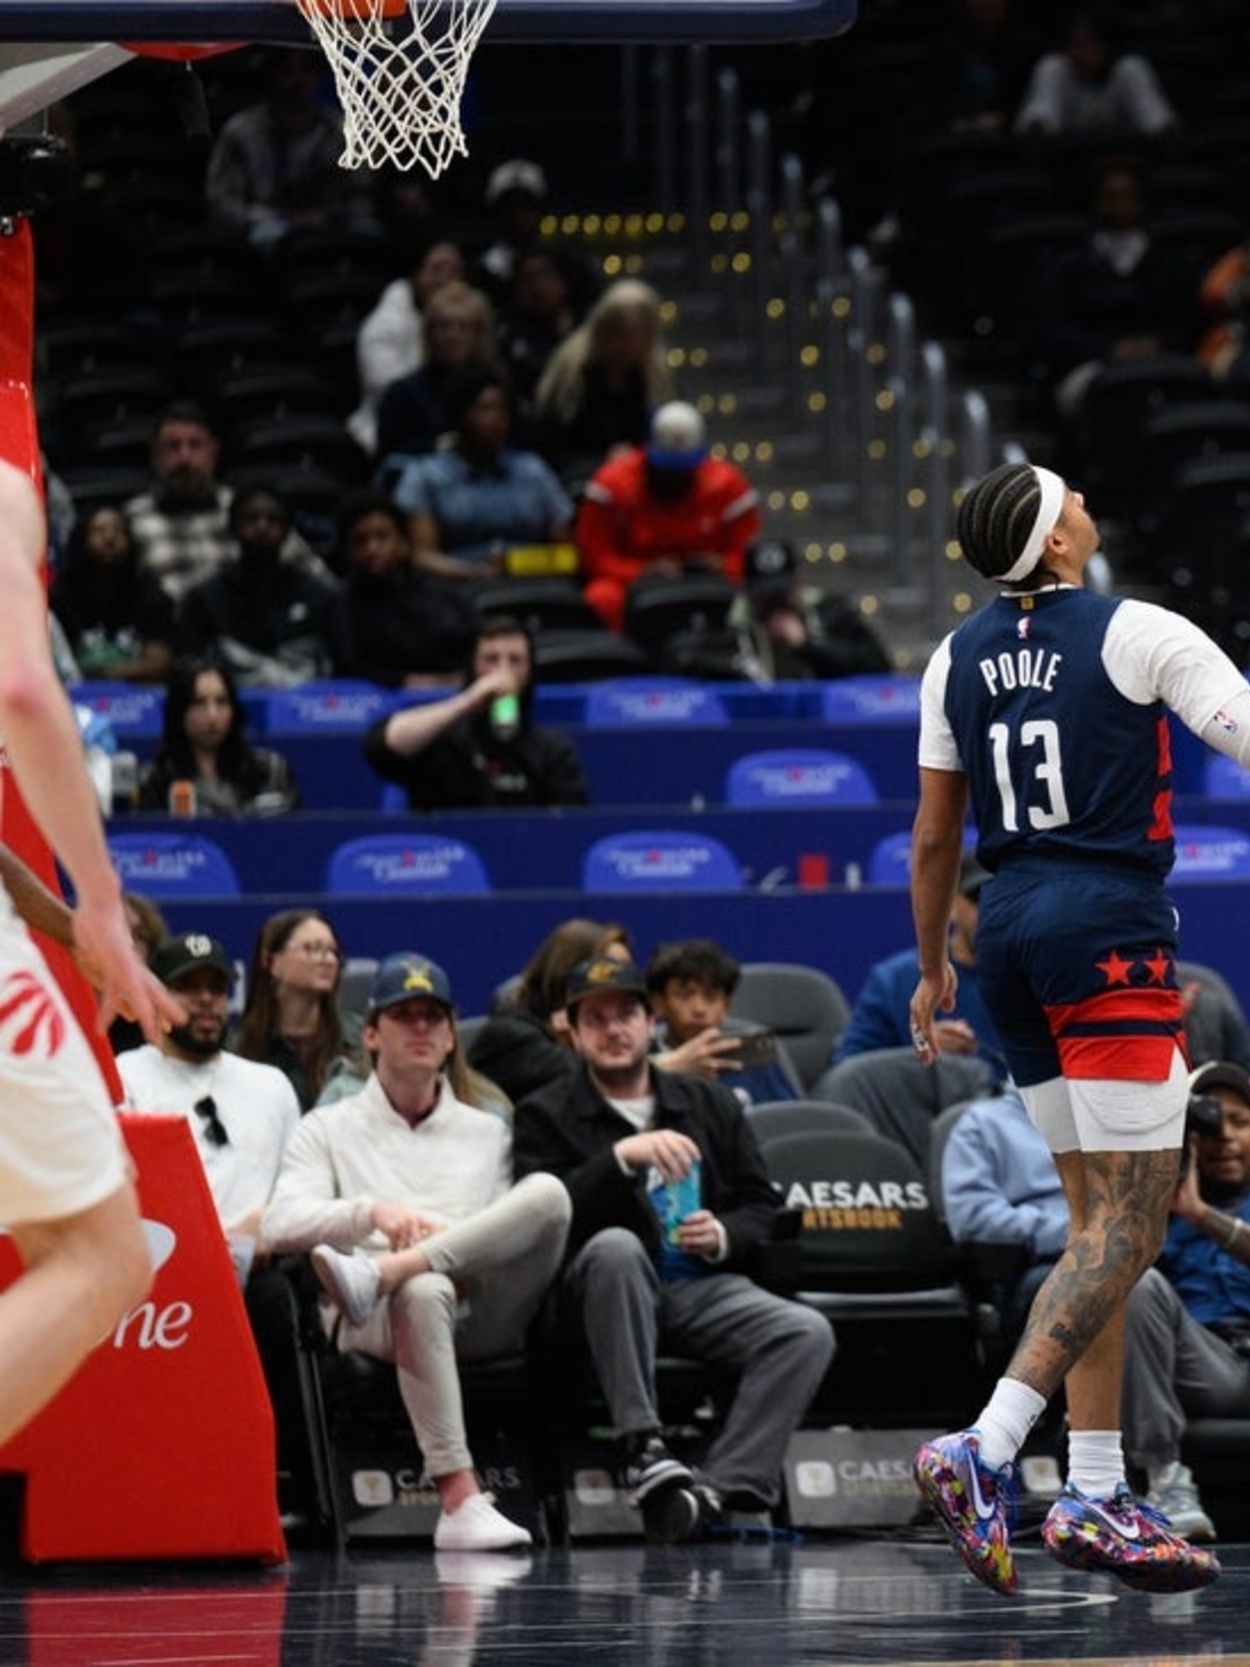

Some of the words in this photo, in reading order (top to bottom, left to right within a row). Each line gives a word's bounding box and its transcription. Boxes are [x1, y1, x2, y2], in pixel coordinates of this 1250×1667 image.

[979, 649, 1063, 697] POOLE
[988, 719, 1071, 832] 13
[771, 1180, 929, 1210] AESARS
[112, 1300, 193, 1350] ne
